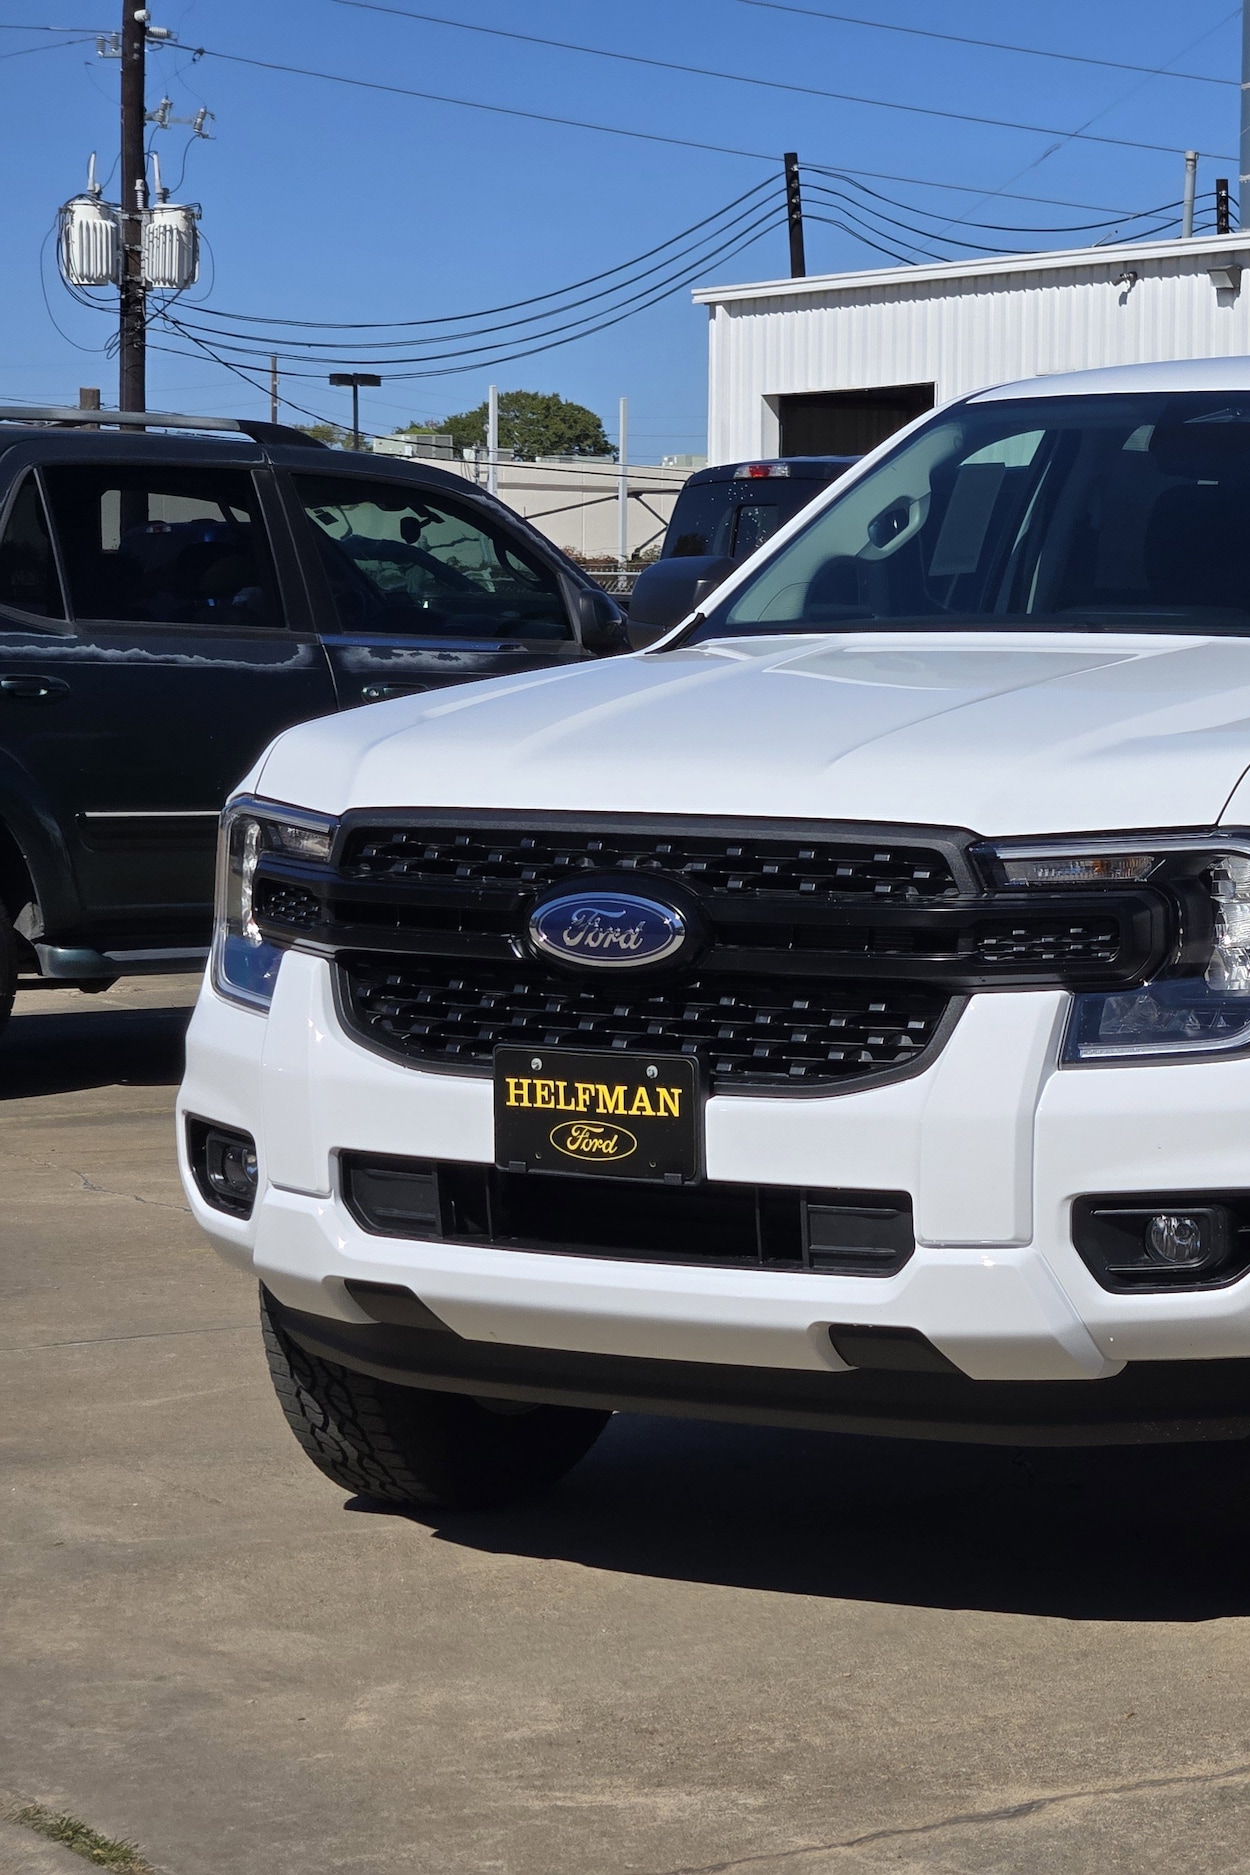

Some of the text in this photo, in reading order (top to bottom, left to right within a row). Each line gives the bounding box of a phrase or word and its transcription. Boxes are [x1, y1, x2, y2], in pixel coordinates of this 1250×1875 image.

[562, 907, 646, 950] Ford
[505, 1077, 682, 1118] HELFMAN
[566, 1125, 619, 1155] Ford
